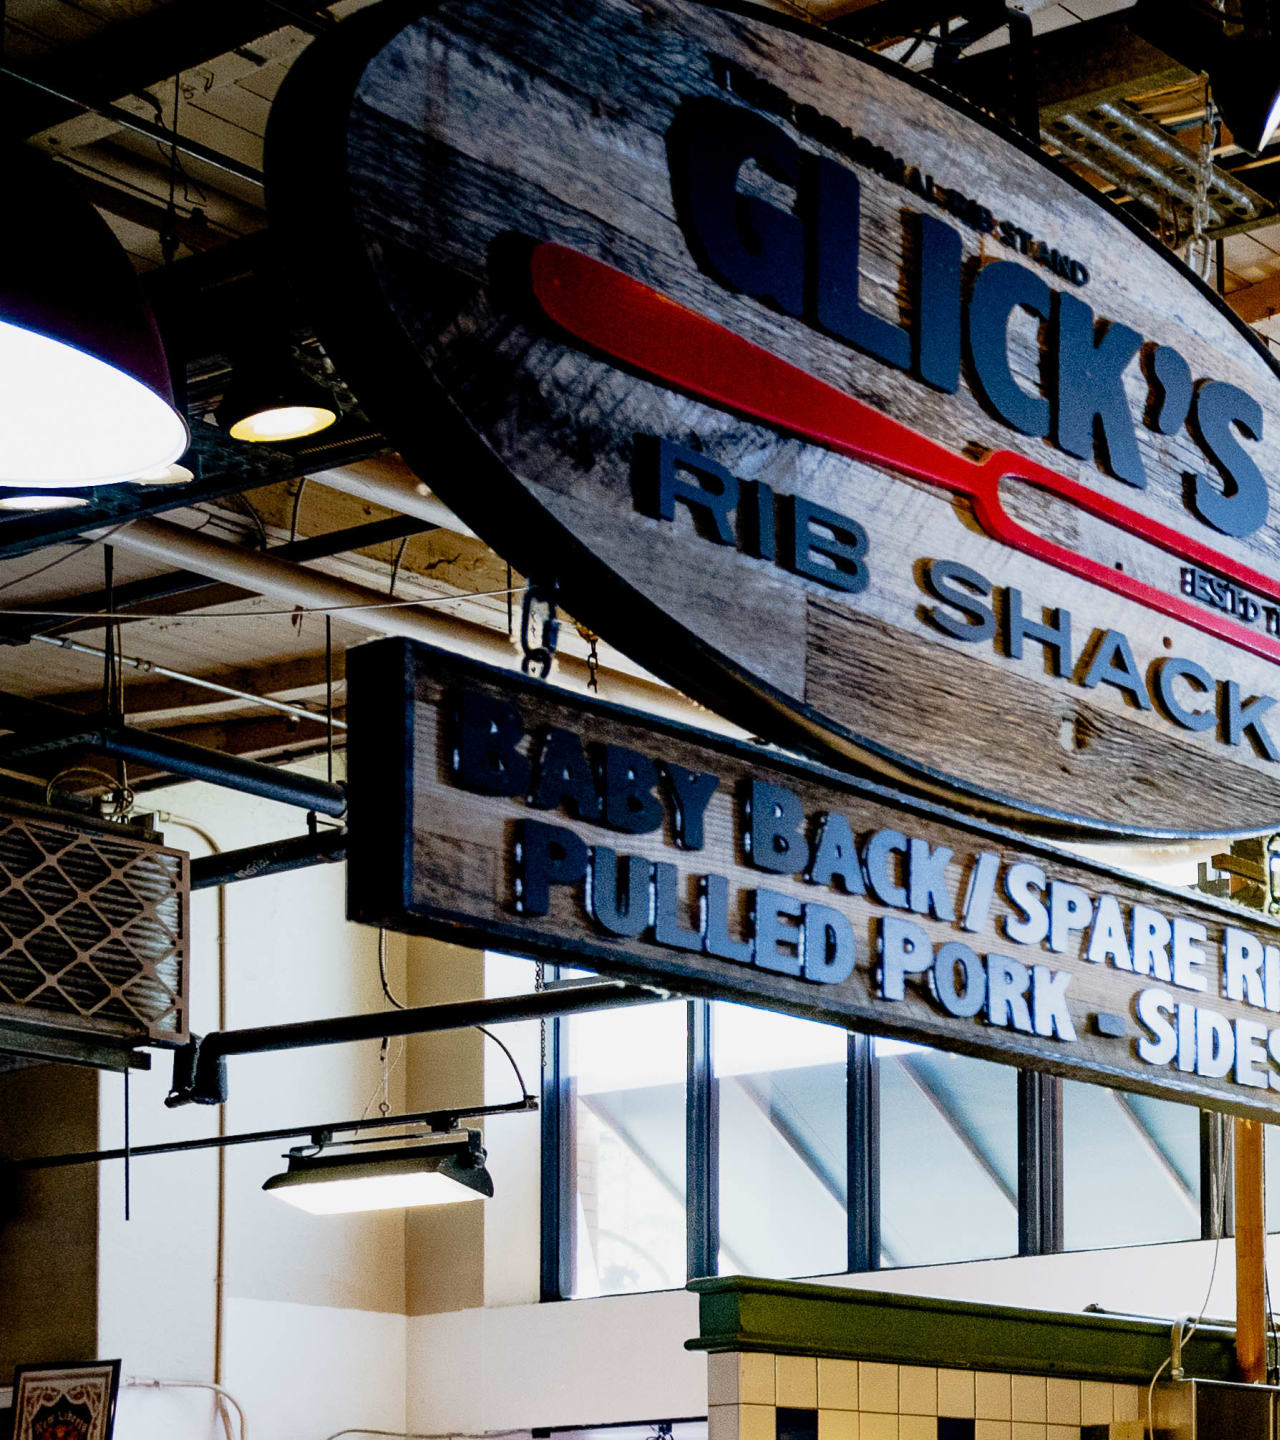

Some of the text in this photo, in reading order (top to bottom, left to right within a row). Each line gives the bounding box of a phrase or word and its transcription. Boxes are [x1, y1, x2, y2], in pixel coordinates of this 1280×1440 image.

[668, 96, 1269, 539] GLICK'S
[638, 434, 871, 594] RIB
[450, 689, 719, 851] BABY
[512, 816, 857, 986] PULLED
[877, 915, 1077, 1042] PORK
